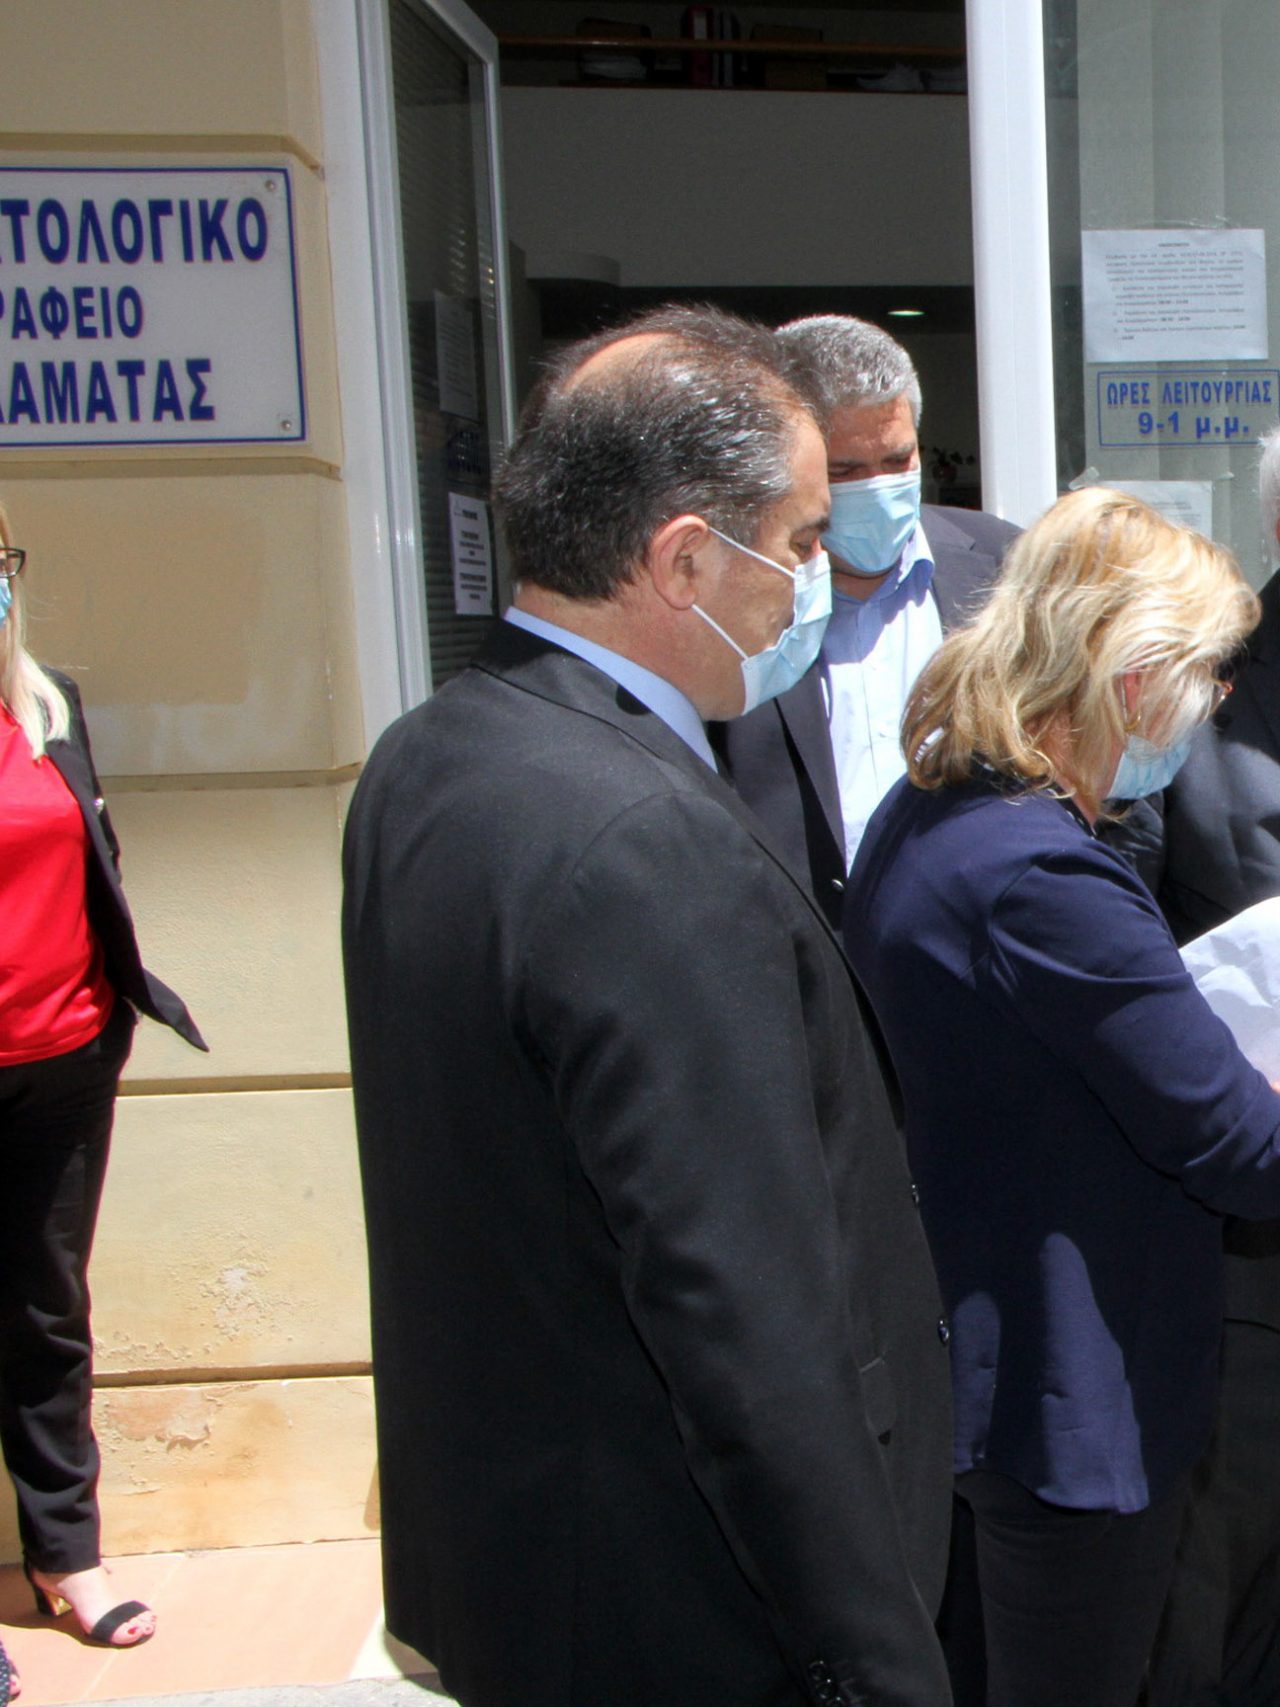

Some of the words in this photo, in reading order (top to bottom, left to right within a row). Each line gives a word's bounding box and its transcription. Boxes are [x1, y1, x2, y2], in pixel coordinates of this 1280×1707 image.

[0, 198, 268, 264] ΤΟΛΟΓΙΚΟ
[0, 285, 144, 339] ΑΦΕΙΟ
[0, 358, 215, 424] ΑΜΑΤΑΣ
[1107, 382, 1150, 405] ΩΡΕΣ
[1162, 380, 1272, 404] ΛΕΙΤΟΥΡΓΙΑΣ
[1138, 411, 1180, 434] 9-1
